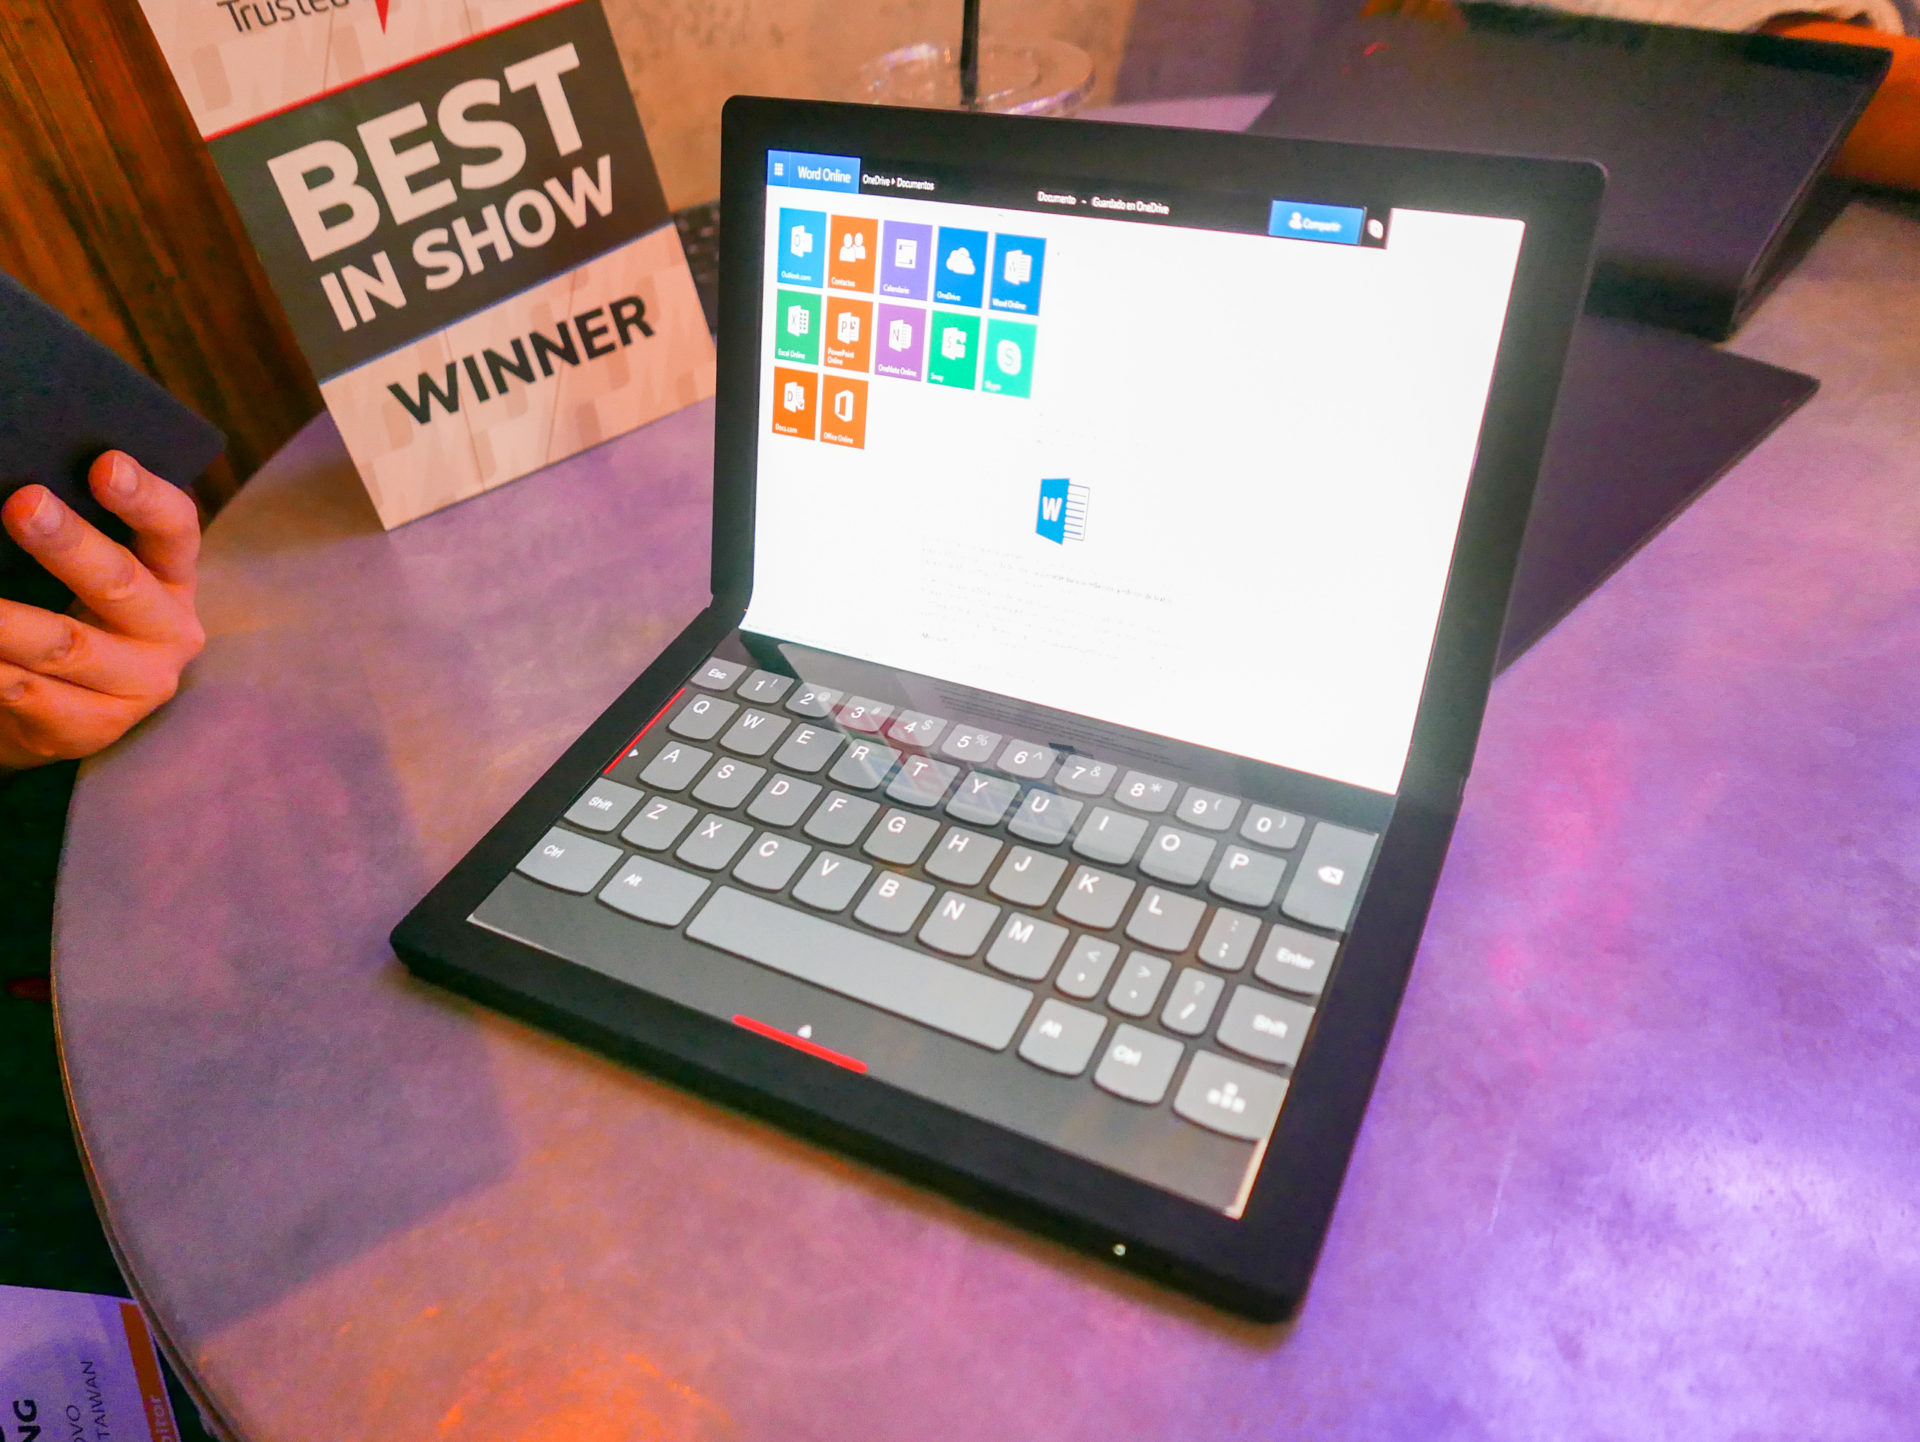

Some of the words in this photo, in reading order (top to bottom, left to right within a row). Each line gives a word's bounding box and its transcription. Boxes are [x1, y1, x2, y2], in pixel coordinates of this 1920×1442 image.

[216, 0, 350, 32] Truste
[267, 42, 582, 262] BEST
[797, 165, 822, 180] Word
[823, 167, 852, 183] Online
[862, 173, 891, 188] OneDrive
[896, 177, 935, 191] Documentos
[321, 251, 407, 332] IN
[412, 155, 613, 291] SHOW
[387, 295, 656, 425] WINNER
[1042, 496, 1063, 522] W
[708, 668, 727, 679] Esc
[754, 680, 766, 691] 1
[799, 693, 815, 705] 2
[693, 700, 710, 715] Q
[851, 706, 865, 719] 3
[743, 714, 765, 729] W
[903, 720, 917, 733] 4
[796, 730, 815, 745] E
[956, 735, 972, 748] 5
[662, 749, 681, 763] A
[851, 746, 870, 761] R
[1014, 751, 1028, 764] 6
[717, 764, 735, 779] S
[911, 762, 927, 776] T
[1072, 766, 1086, 780] 7
[770, 780, 789, 795] D
[972, 779, 988, 795] Y
[1130, 782, 1146, 797] 8
[587, 796, 614, 811] Shift
[646, 803, 668, 820] Z
[828, 798, 847, 812] F
[1031, 796, 1050, 813] U
[1192, 799, 1207, 814] 9
[701, 821, 723, 839] X
[887, 816, 907, 833] G
[759, 840, 778, 857] C
[948, 834, 970, 852] H
[1161, 833, 1181, 851] O
[543, 844, 565, 858] Ctrl
[820, 858, 839, 877] V
[1014, 856, 1033, 872] J
[1230, 853, 1250, 869] P
[624, 872, 643, 887] Alt
[1077, 873, 1100, 894] K
[878, 879, 900, 898] B
[942, 899, 966, 920] N
[1148, 895, 1163, 916] L
[1008, 920, 1035, 943] M
[1275, 947, 1315, 970] Enter
[80, 1360, 111, 1438] TAIWAN
